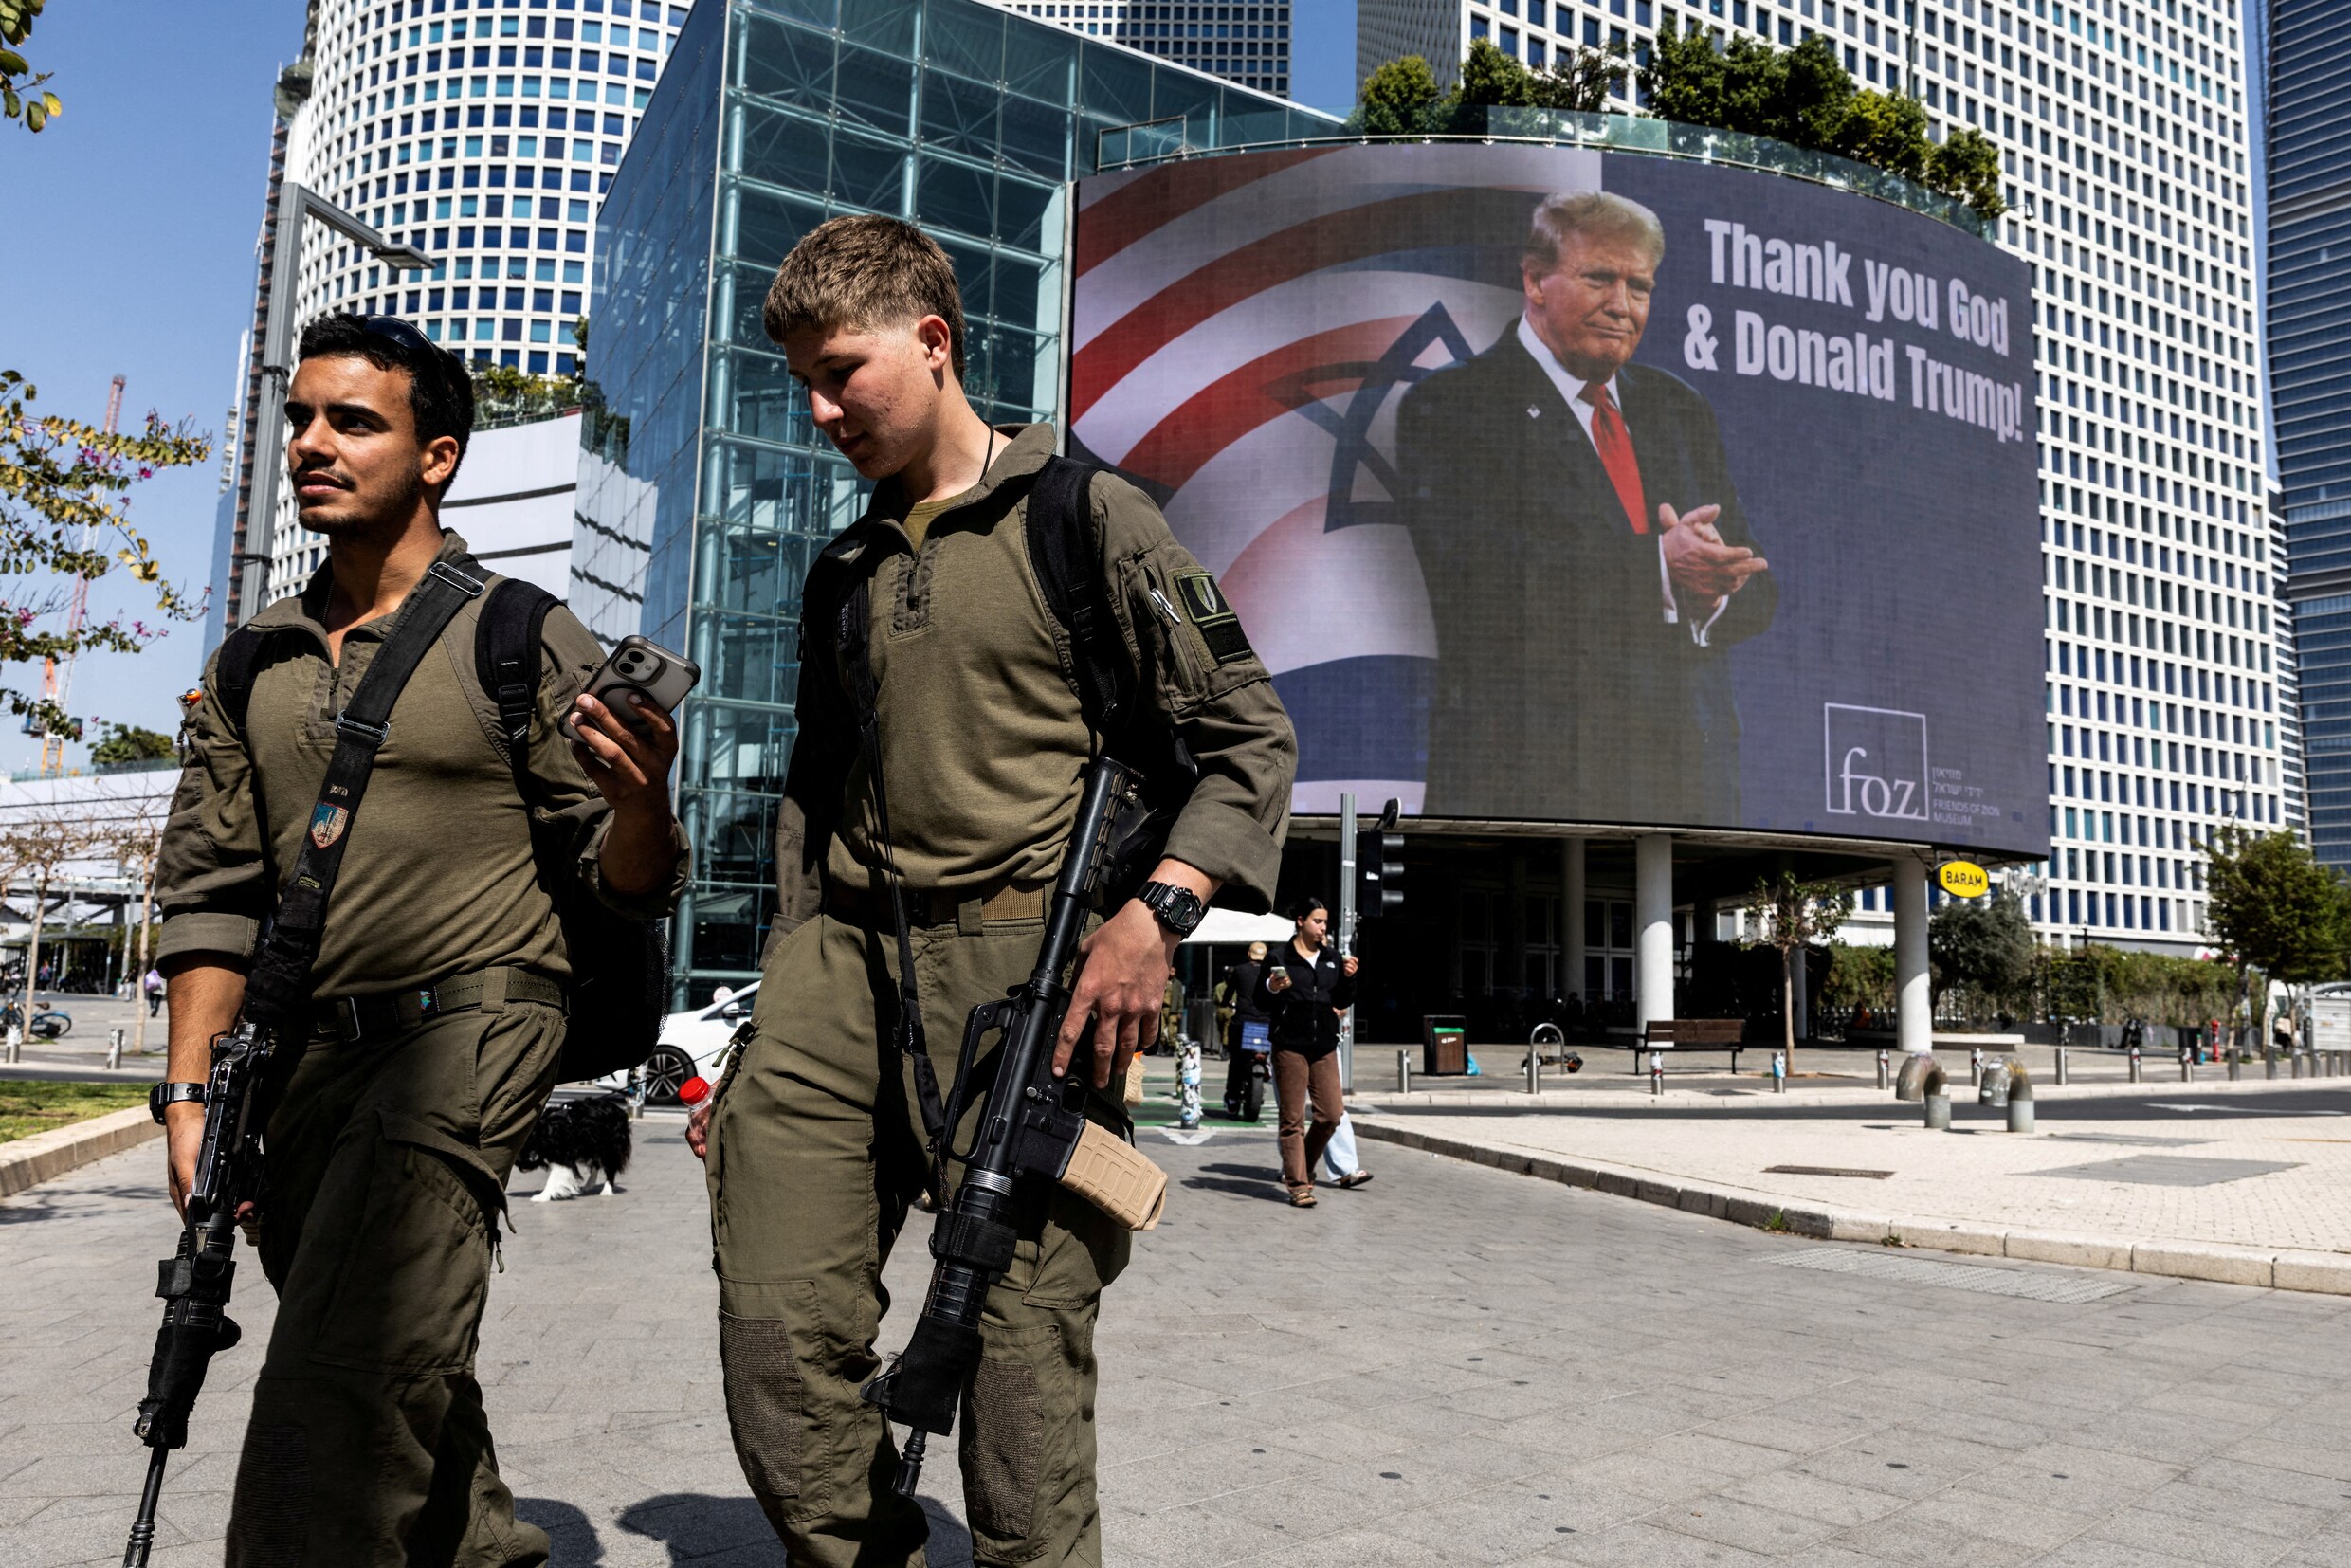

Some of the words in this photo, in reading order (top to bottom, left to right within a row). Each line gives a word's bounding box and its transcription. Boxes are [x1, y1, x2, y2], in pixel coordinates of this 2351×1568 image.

[1704, 219, 1854, 308] Thank
[1865, 258, 1939, 330] you
[1948, 278, 2010, 356] God
[1684, 303, 1719, 372] &
[1735, 309, 1895, 402] Donald
[1905, 345, 2023, 442] Trump!
[1932, 766, 1961, 780] מוזיאון
[1839, 747, 1920, 818] foz
[1932, 781, 1962, 795] ישראל
[1933, 799, 1969, 813] FRIENDS
[1970, 803, 1980, 813] OF
[1981, 804, 2000, 817] ZION
[1933, 812, 1972, 826] MUSEUM
[1946, 871, 1982, 886] BARAM
